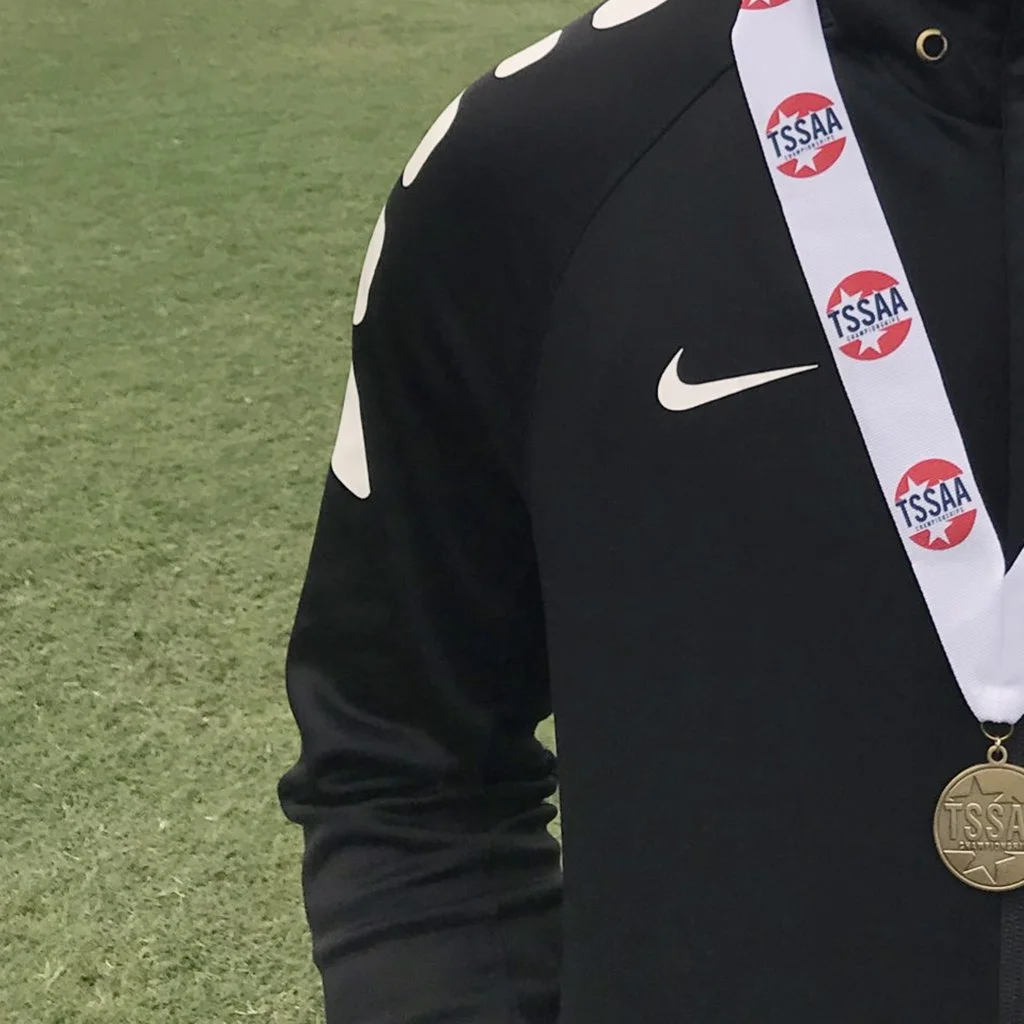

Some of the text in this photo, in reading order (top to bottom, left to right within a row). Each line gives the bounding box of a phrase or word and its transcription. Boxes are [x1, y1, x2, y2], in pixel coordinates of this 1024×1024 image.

[767, 107, 843, 157] TSSAA
[827, 287, 908, 338] TSSAA
[896, 477, 971, 528] TSSAA
